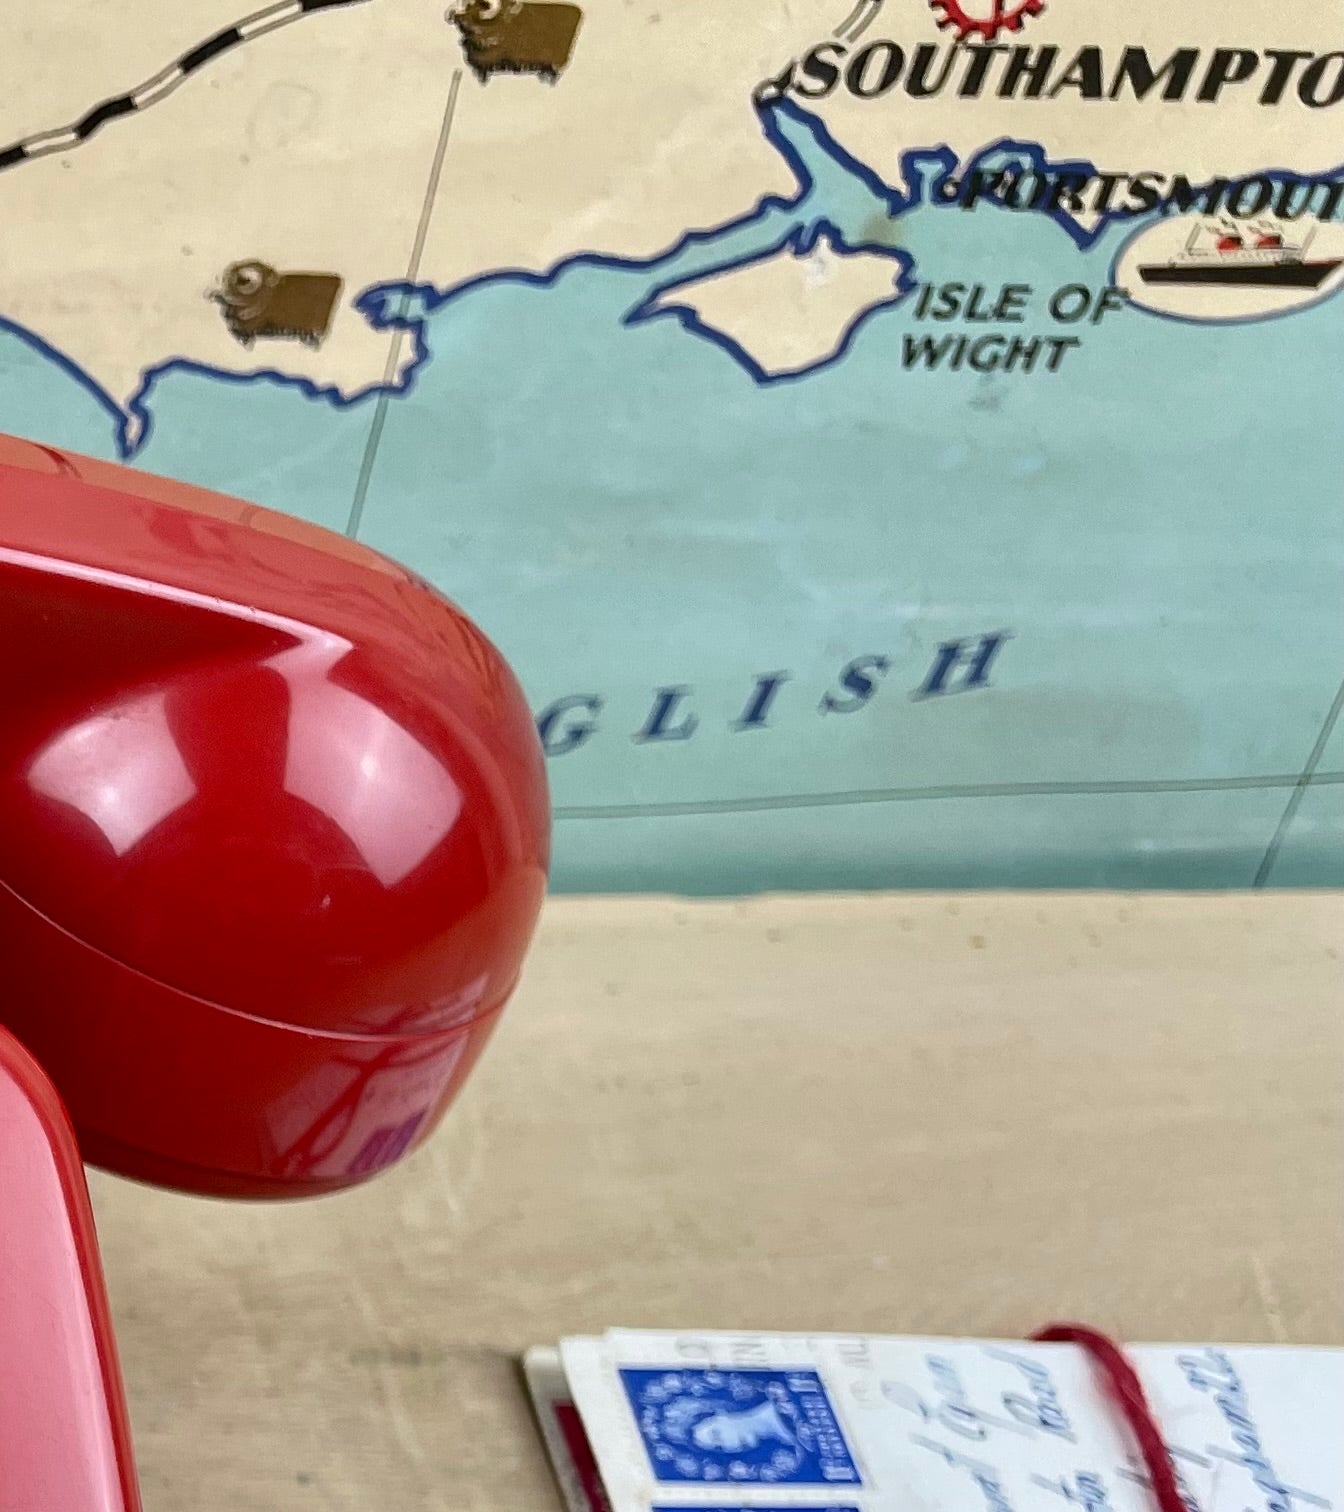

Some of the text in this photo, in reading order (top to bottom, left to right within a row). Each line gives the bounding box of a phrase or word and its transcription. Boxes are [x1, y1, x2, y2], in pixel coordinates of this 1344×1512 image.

[794, 41, 1344, 108] SOUTHAMPTO
[913, 281, 1131, 326] ISLE OF
[901, 333, 1082, 374] WIGHT
